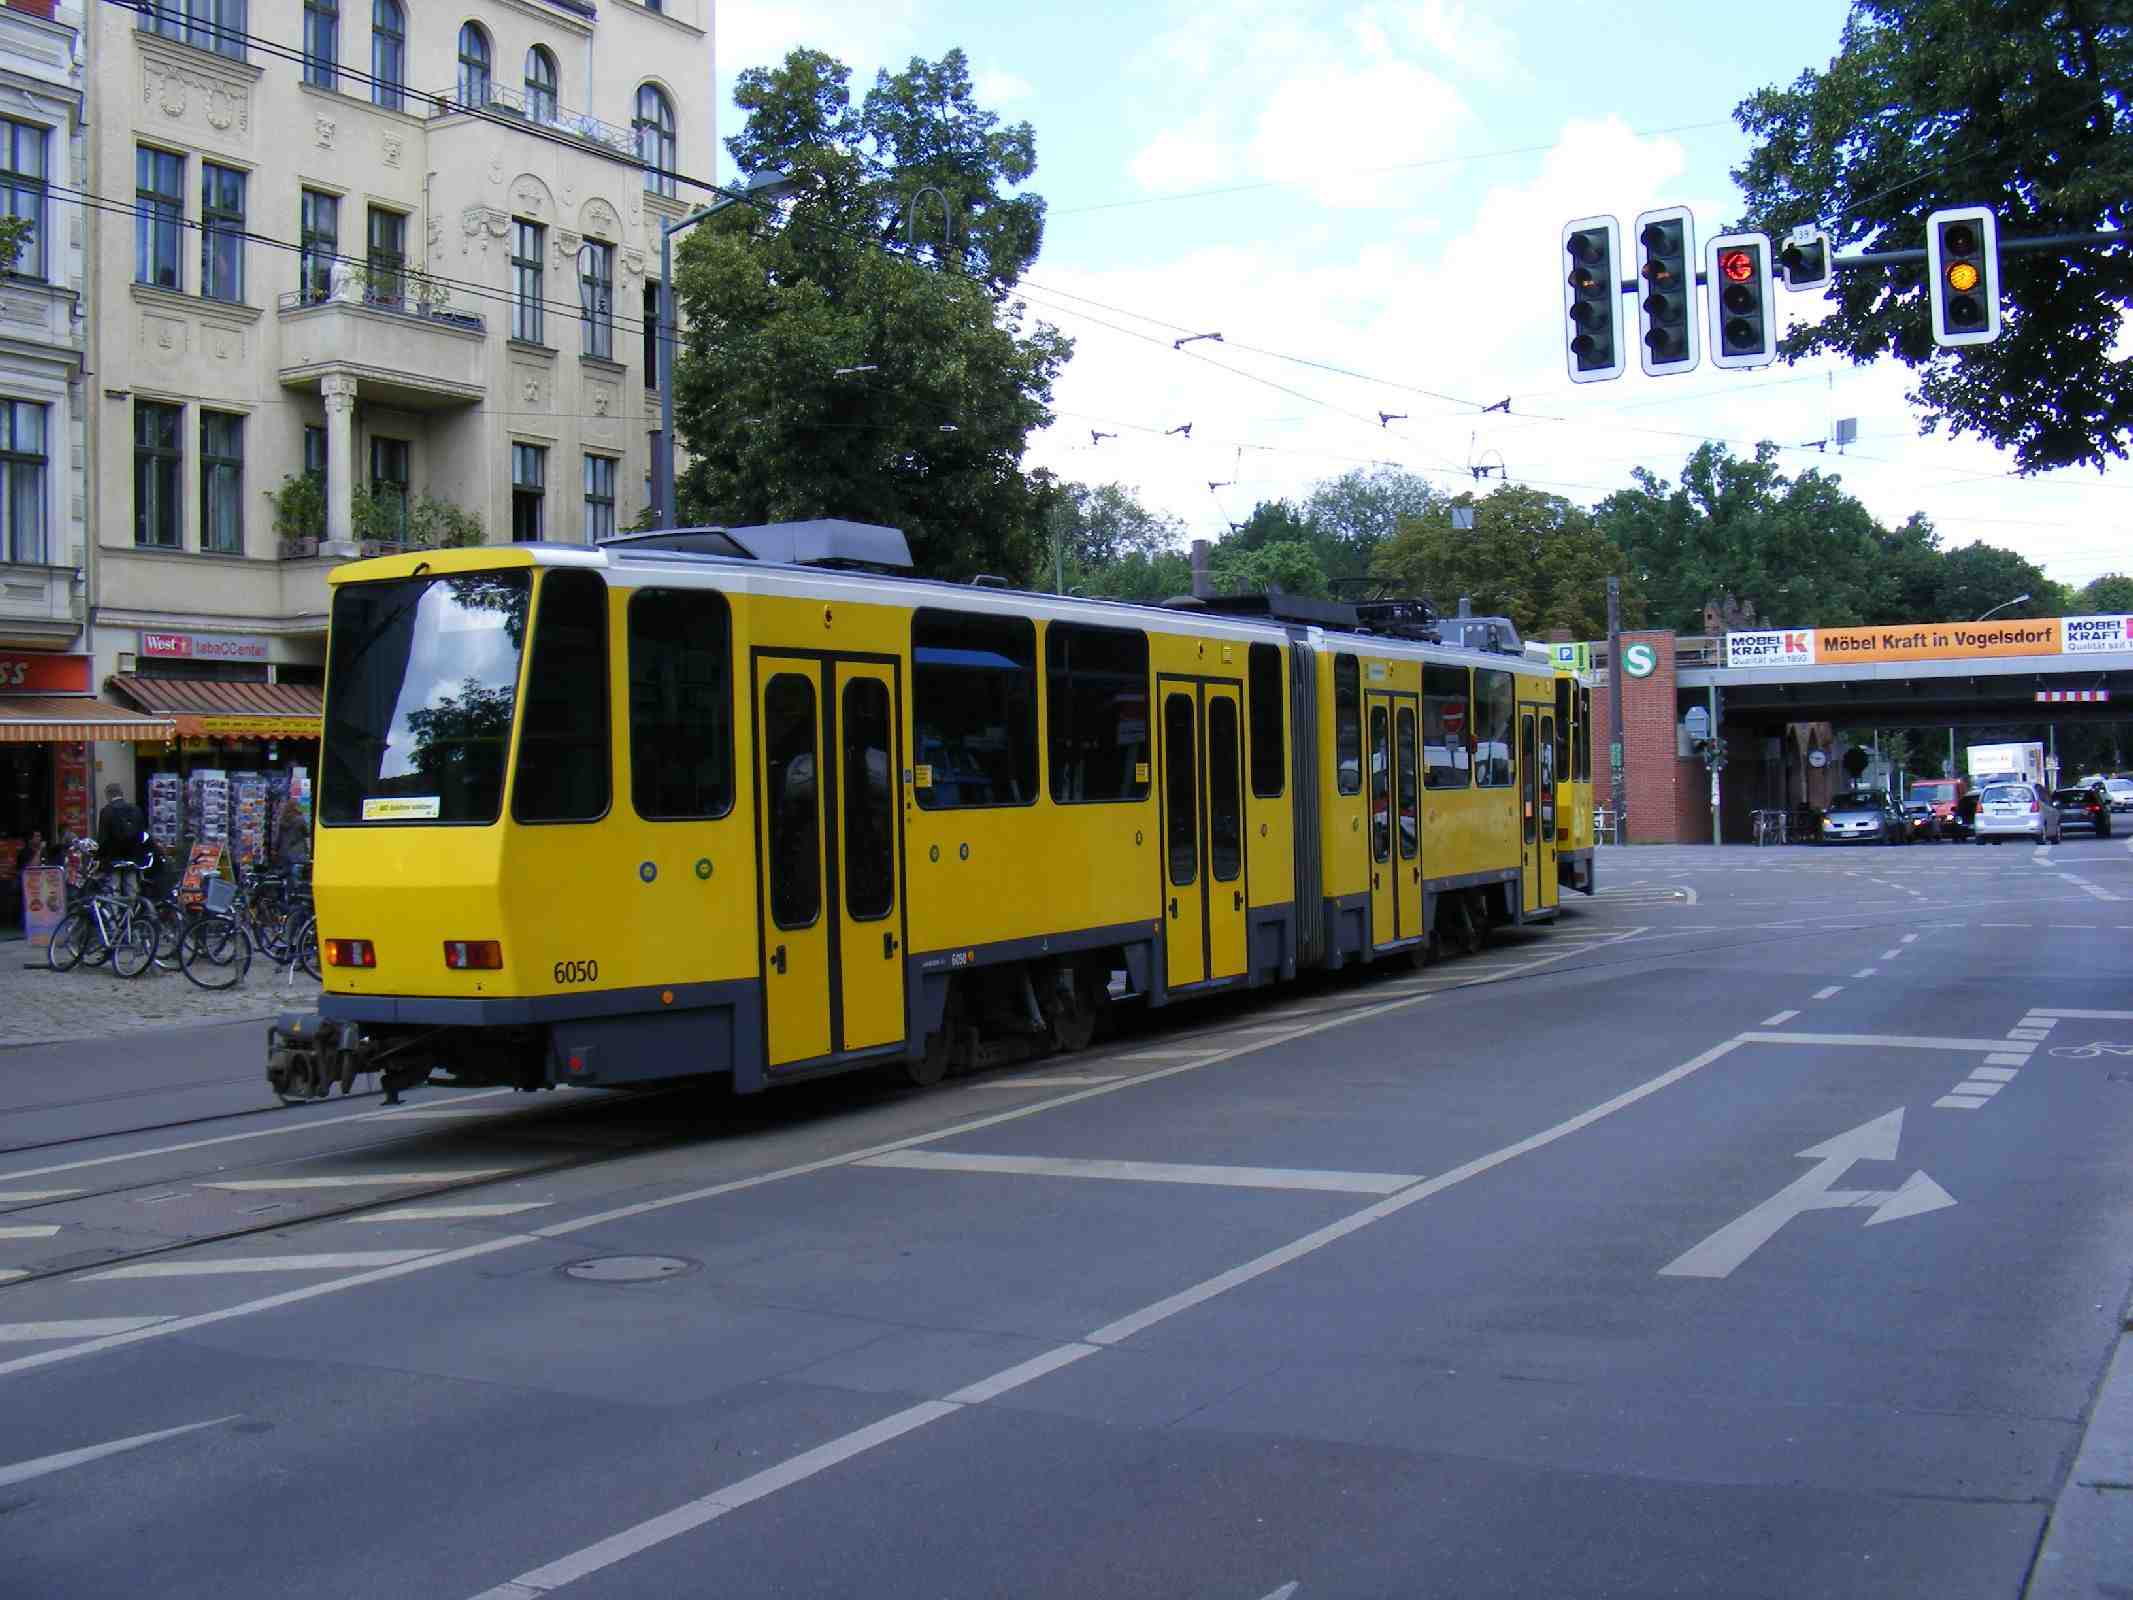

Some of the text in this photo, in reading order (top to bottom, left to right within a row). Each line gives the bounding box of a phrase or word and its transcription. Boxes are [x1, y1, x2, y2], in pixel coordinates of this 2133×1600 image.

[146, 635, 177, 651] West
[1824, 628, 2053, 651] Möbel Kraft in Vogelsdorf
[2068, 631, 2121, 641] KRAFT
[1731, 645, 1779, 655] KRAFT
[553, 959, 599, 984] 6050
